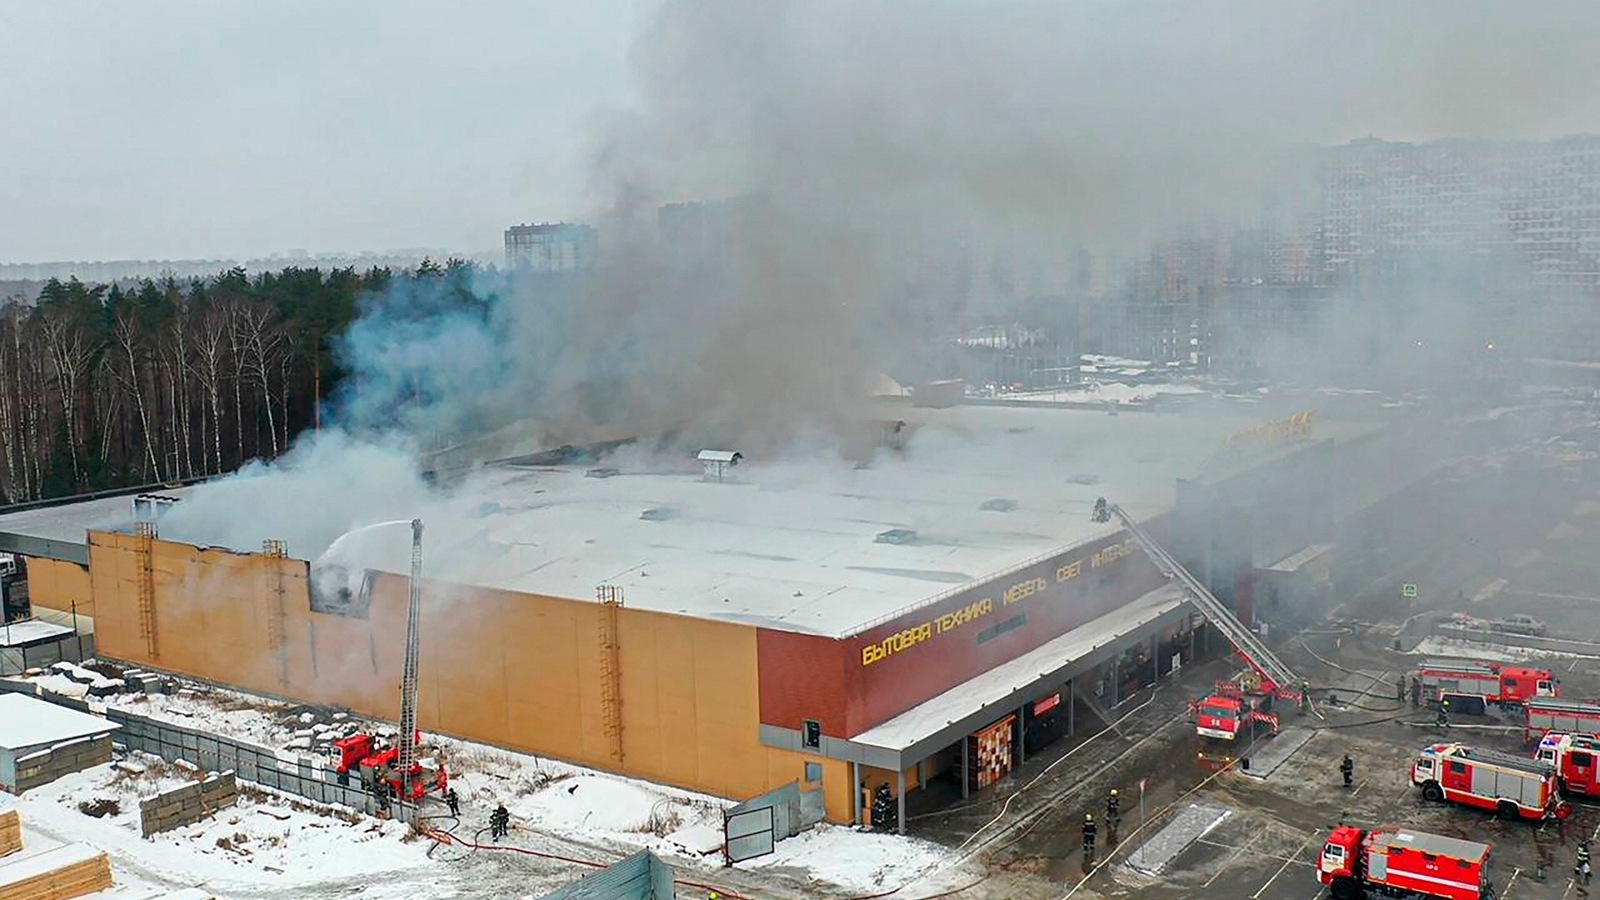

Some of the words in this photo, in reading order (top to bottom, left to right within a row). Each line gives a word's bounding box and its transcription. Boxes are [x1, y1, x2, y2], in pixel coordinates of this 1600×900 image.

[862, 622, 931, 666] БЫТОВАЯ
[934, 598, 993, 634] ТЕХНИКА
[1003, 577, 1047, 606] МЕБЕЛЬ
[1056, 560, 1083, 583] СВЕТ
